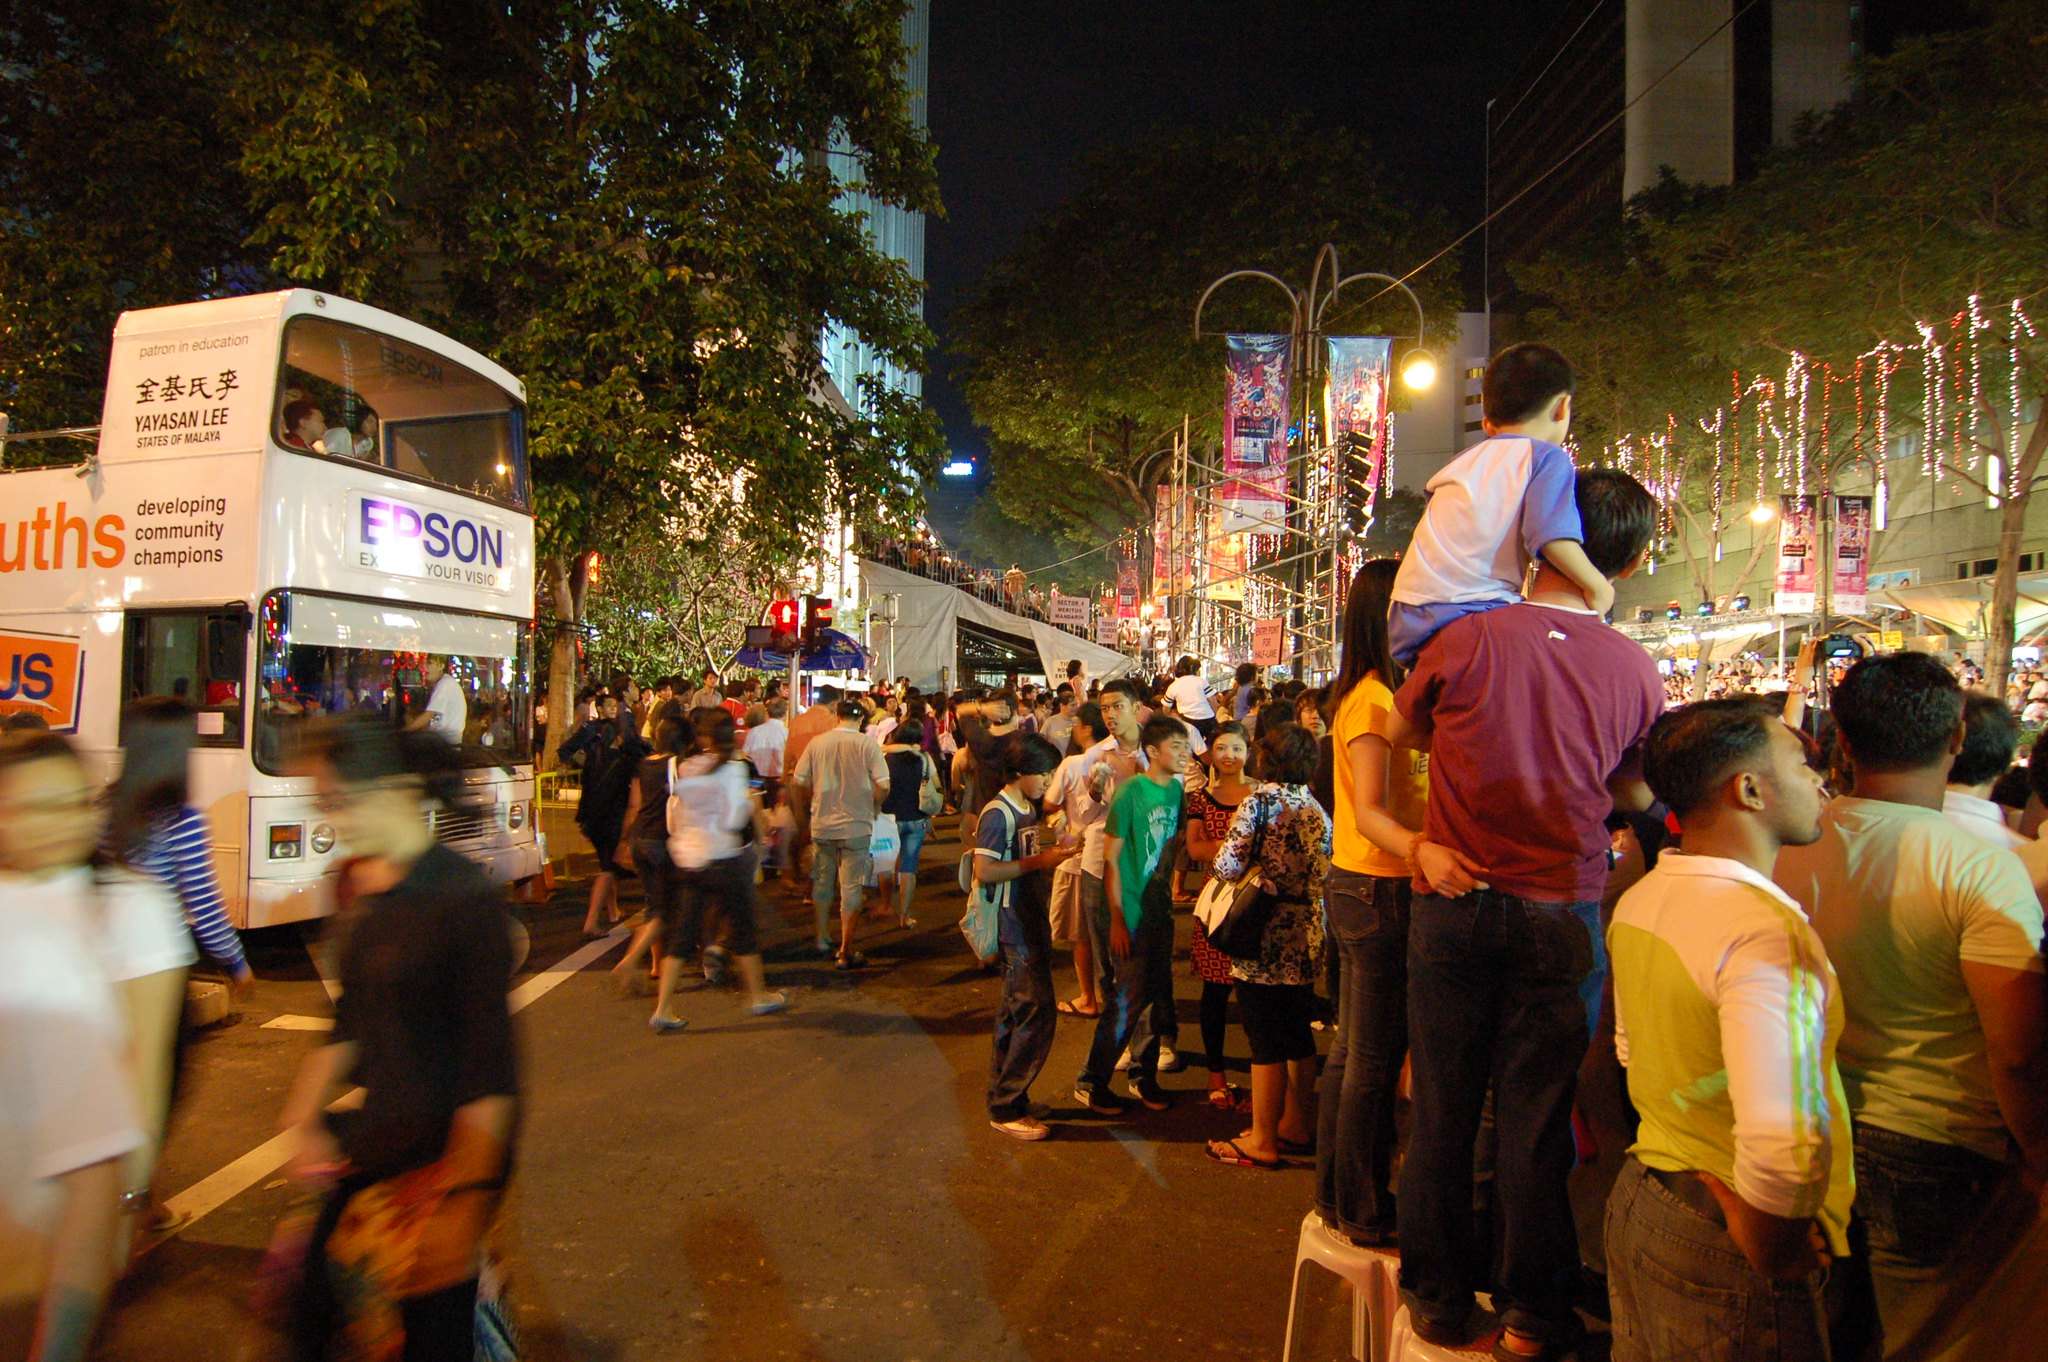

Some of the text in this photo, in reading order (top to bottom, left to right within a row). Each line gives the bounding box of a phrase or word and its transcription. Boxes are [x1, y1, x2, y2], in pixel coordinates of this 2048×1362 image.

[140, 335, 249, 360] patron in education
[135, 407, 229, 433] YAYASAN LEE
[137, 431, 220, 448] STATES OF MALAYA
[137, 496, 226, 516] developing
[0, 502, 126, 573] uths
[135, 520, 224, 541] community
[361, 498, 502, 568] EPSON
[134, 547, 223, 568] champions
[425, 563, 499, 586] YOUR VISIO
[1262, 637, 1271, 648] FOR
